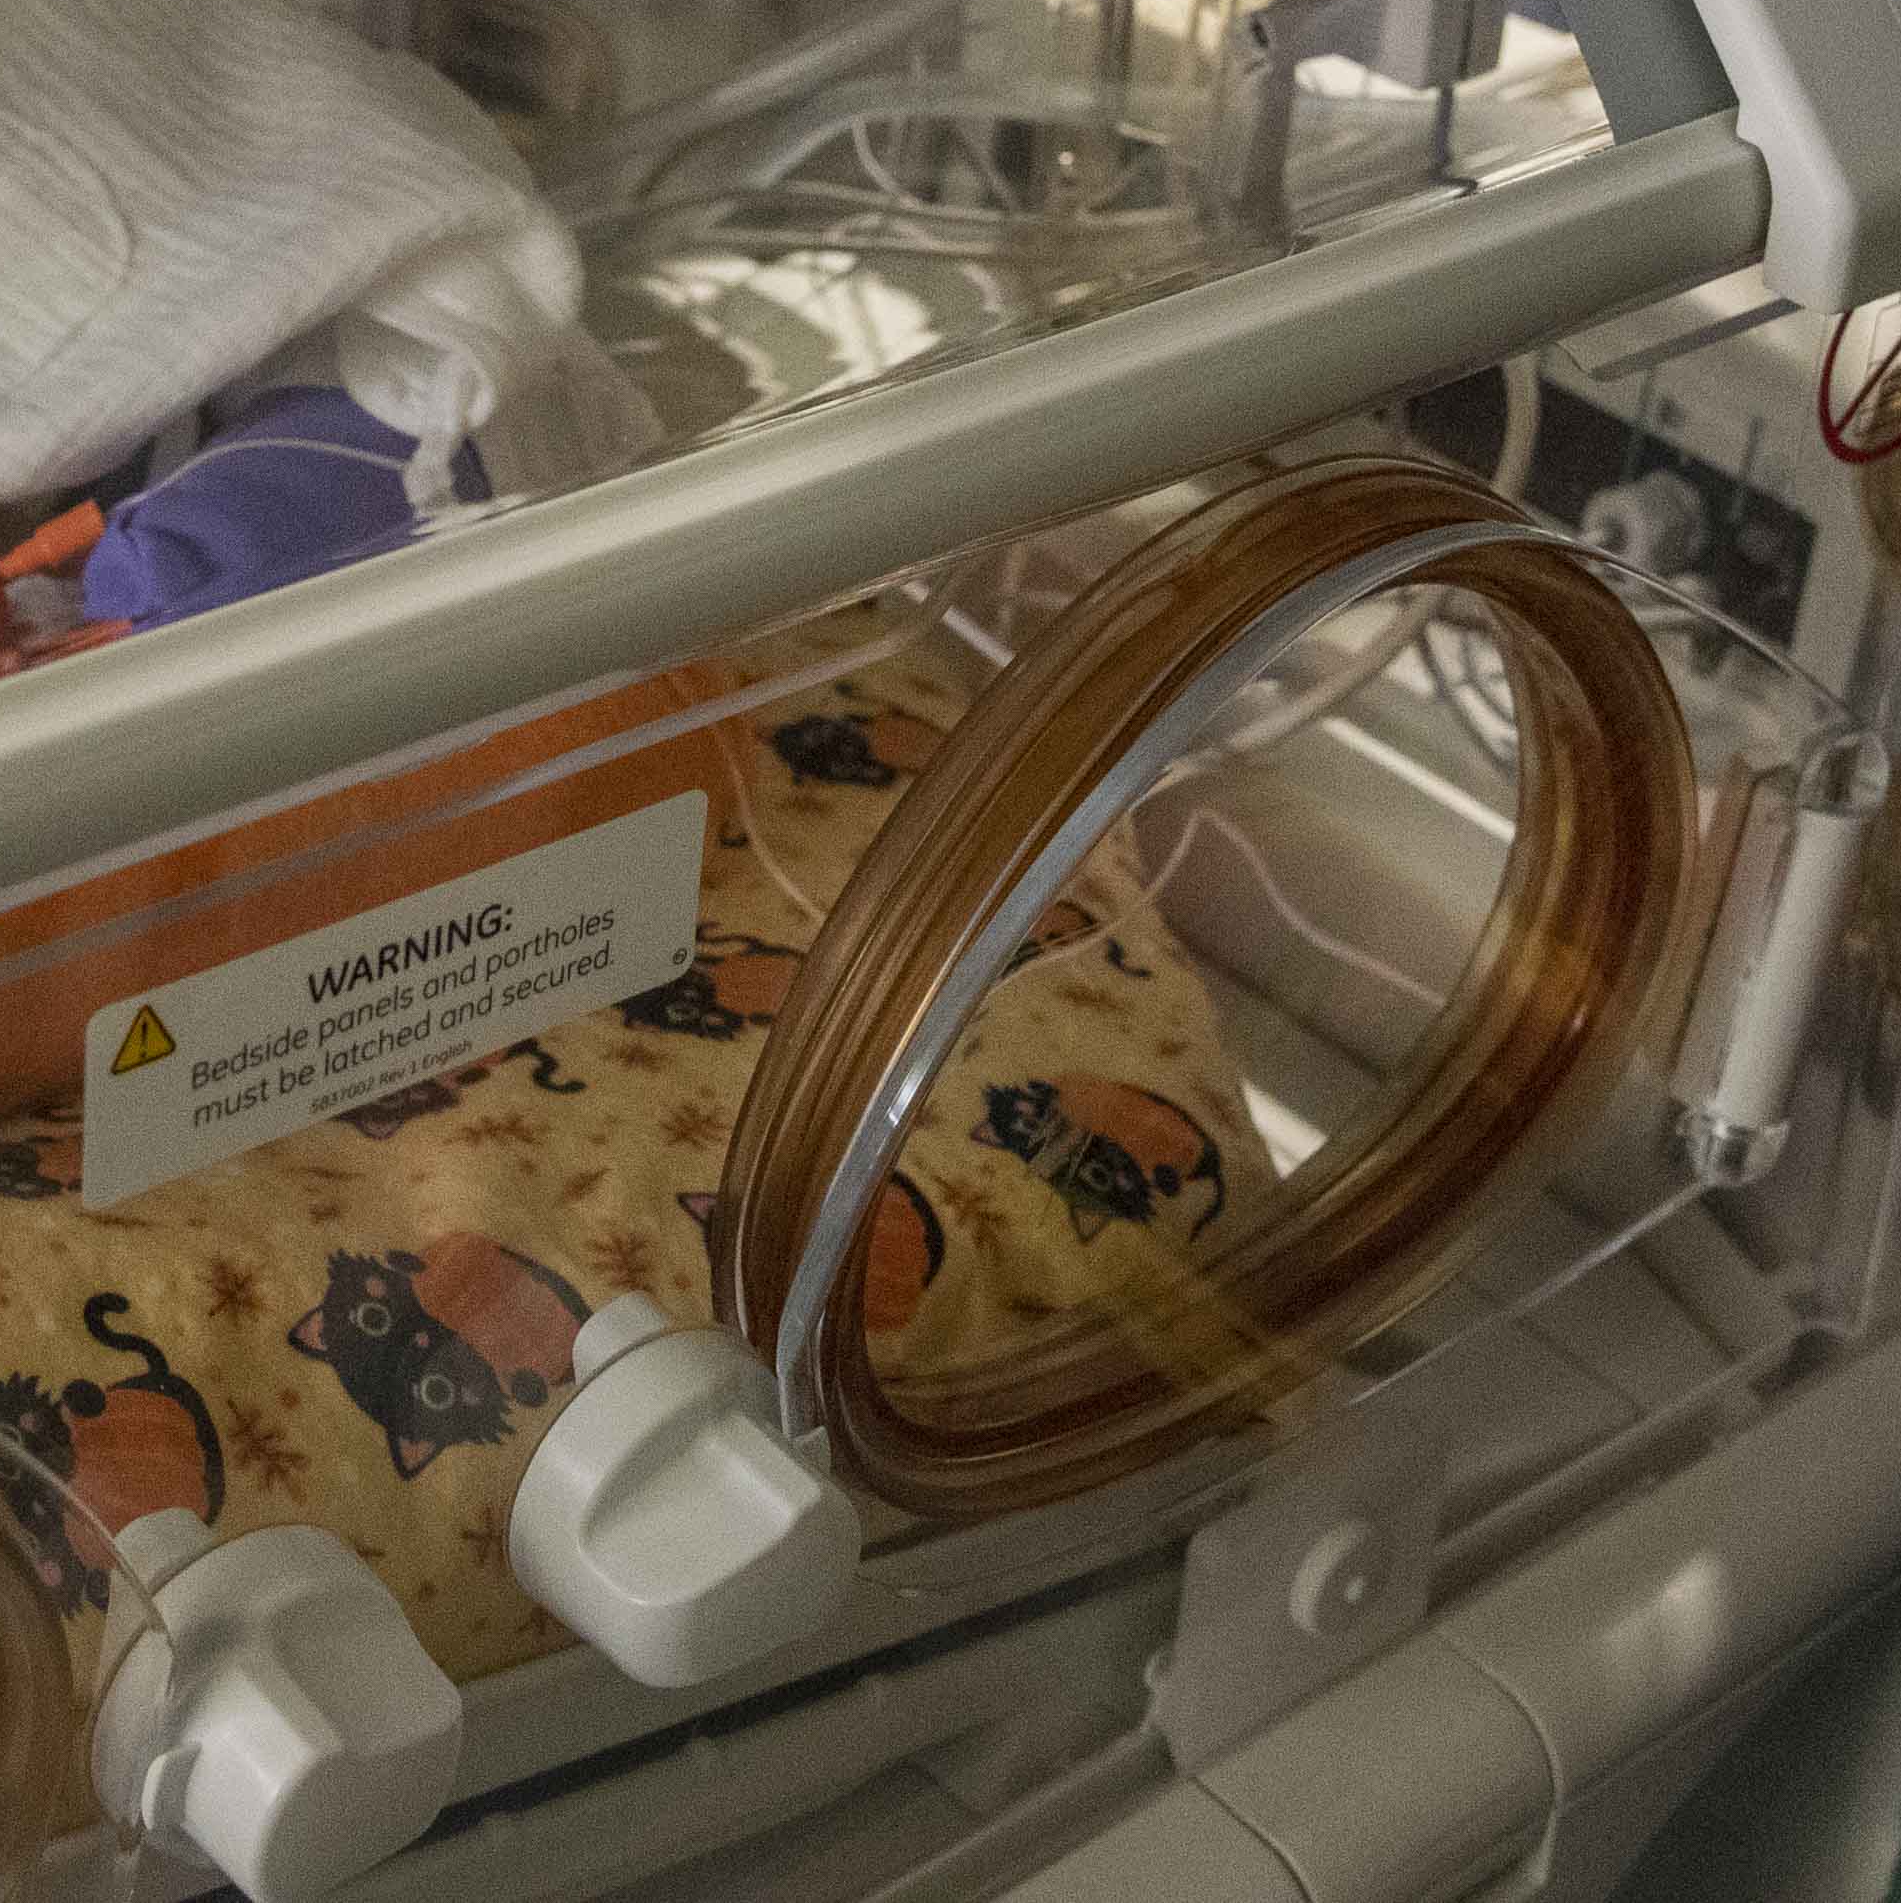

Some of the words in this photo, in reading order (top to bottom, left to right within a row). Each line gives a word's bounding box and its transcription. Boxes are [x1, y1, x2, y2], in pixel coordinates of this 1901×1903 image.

[191, 1026, 309, 1090] Bedside
[318, 985, 414, 1047] panels
[422, 954, 477, 1000] and
[486, 908, 615, 982] portholes
[307, 903, 514, 1005] WARNING:
[193, 1077, 271, 1128] must
[279, 1063, 317, 1095] be
[323, 1008, 431, 1077] latched
[440, 986, 494, 1031] and
[501, 939, 615, 1008] secured.
[421, 1040, 474, 1073] English
